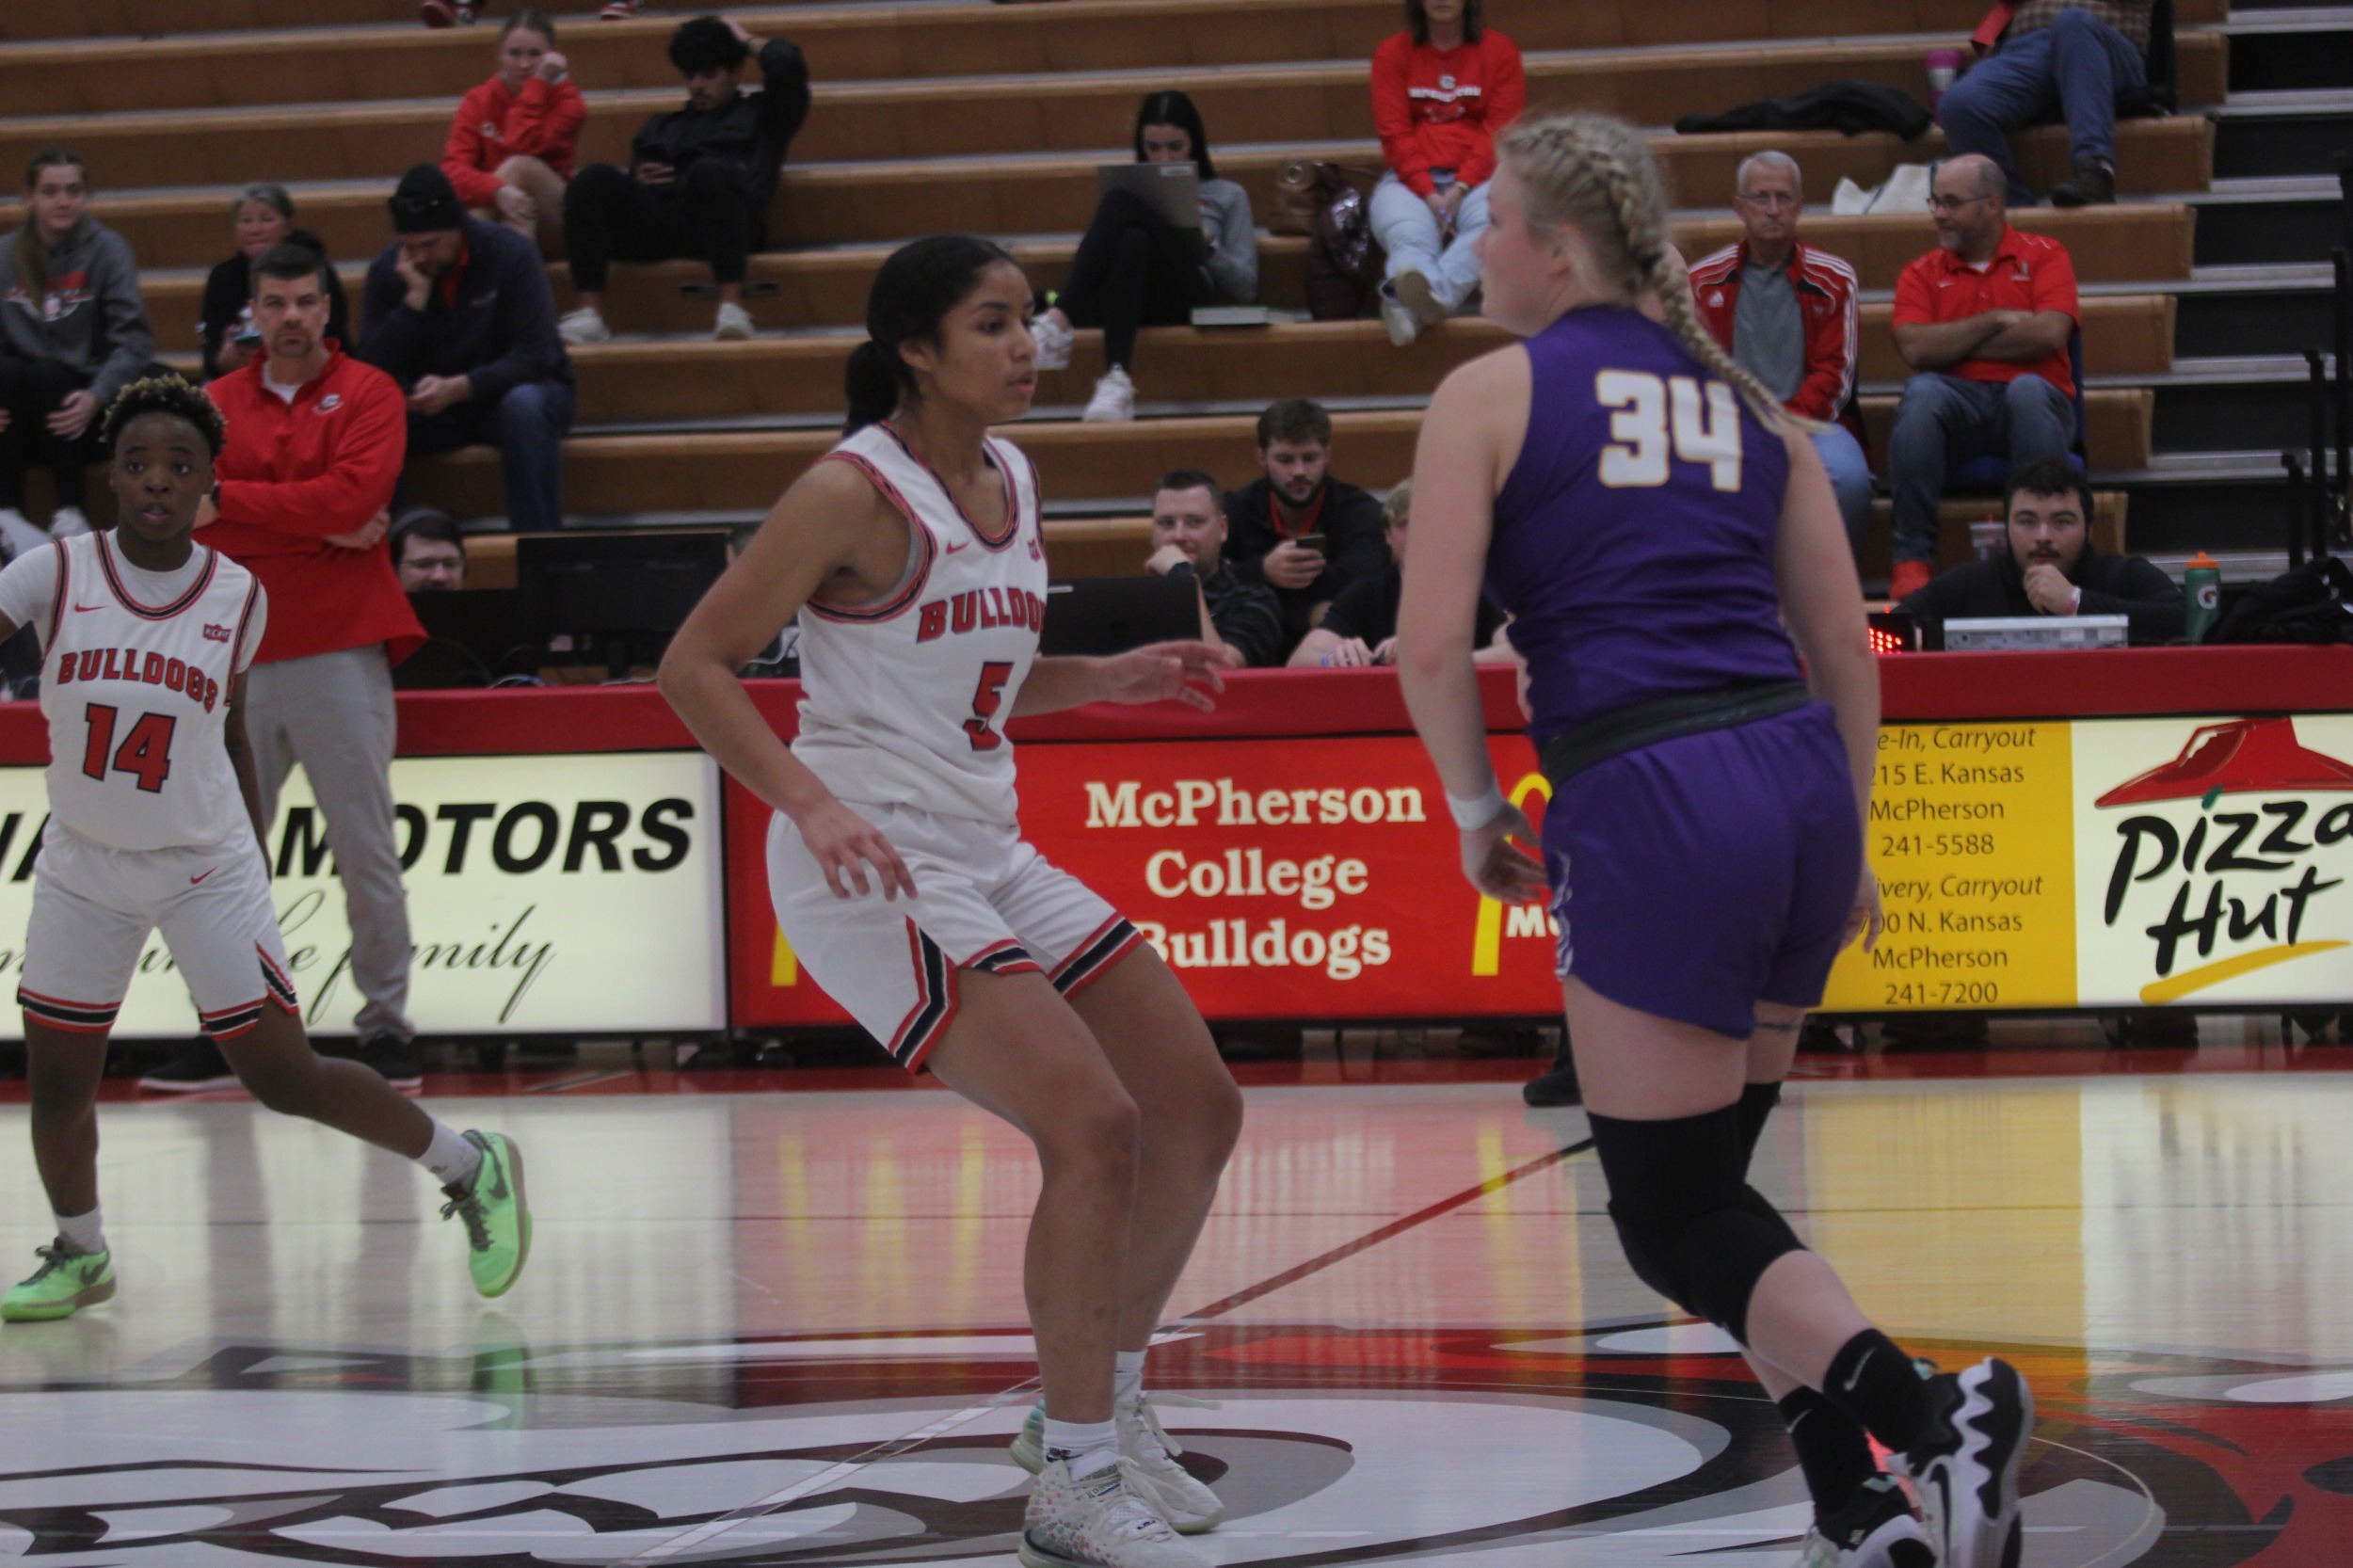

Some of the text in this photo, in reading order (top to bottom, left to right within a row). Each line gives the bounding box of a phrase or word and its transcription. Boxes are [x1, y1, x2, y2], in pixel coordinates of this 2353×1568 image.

[1595, 368, 1743, 493] 34
[56, 648, 219, 714] BULLDOGS
[963, 662, 1015, 752] 5
[83, 702, 177, 793] 14
[1877, 727, 2037, 754] e-In, Carryout
[1914, 763, 1934, 785] E.
[1941, 762, 2025, 784] Kansas
[1084, 777, 1427, 828] McPherson
[1869, 798, 2006, 822] McPherson
[1881, 833, 1995, 857] 241-5588
[2105, 785, 2353, 927] Pizza
[1144, 847, 1369, 910] College
[1940, 874, 2044, 903] Carryout
[1908, 911, 1933, 934] N.
[1940, 910, 2024, 933] Kansas
[2145, 865, 2345, 978] Hut
[1872, 946, 2009, 970] McPherson
[1884, 982, 1999, 1006] 241-7200
